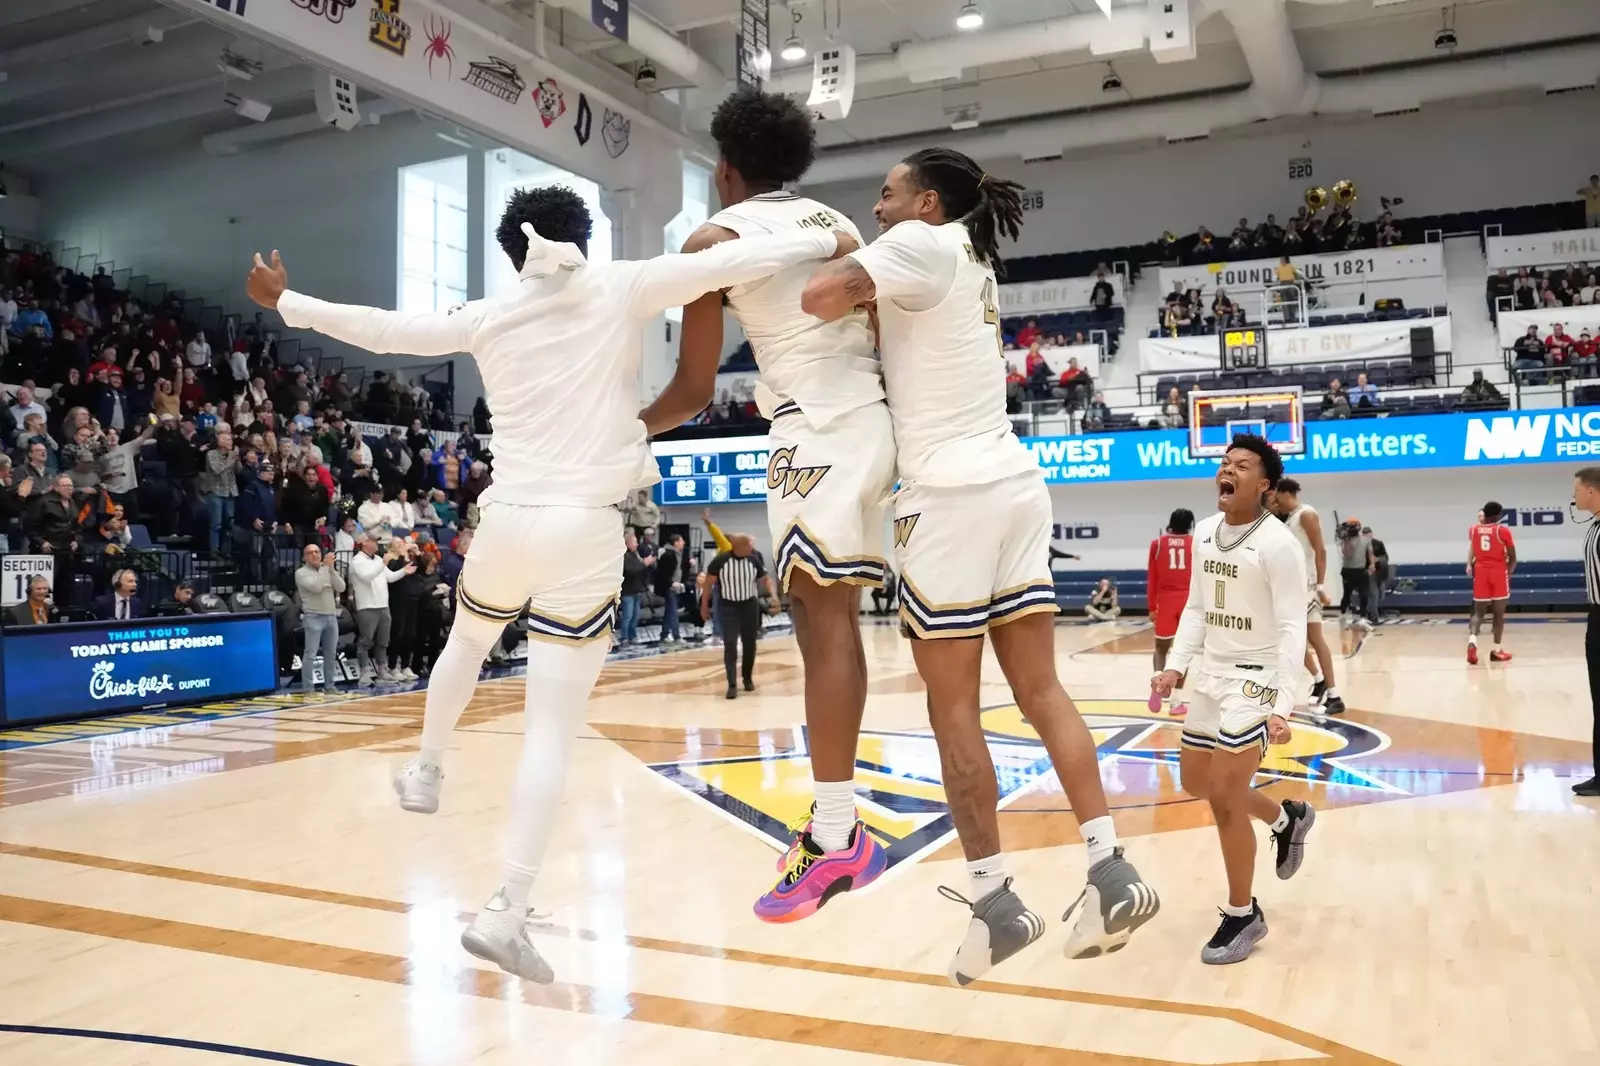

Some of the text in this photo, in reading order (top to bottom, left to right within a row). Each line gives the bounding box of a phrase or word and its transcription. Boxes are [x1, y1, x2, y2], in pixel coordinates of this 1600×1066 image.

[465, 73, 519, 104] BONNIES
[1288, 164, 1313, 179] 220
[1022, 195, 1044, 211] 219
[1552, 237, 1600, 255] HAIL
[1216, 267, 1273, 286] FOUND
[1333, 258, 1375, 277] 1821
[1312, 432, 1437, 460] Matters.
[1463, 414, 1552, 461] NW
[1022, 438, 1115, 464] HWEST
[700, 455, 712, 473] 7
[766, 443, 833, 500] GW
[1062, 463, 1111, 479] UNION
[893, 512, 922, 549] W
[1480, 534, 1491, 552] 6
[3, 560, 53, 572] SECTION
[1168, 547, 1187, 570] 11
[1203, 559, 1239, 579] GEORGE
[1214, 579, 1226, 609] 0
[107, 627, 190, 641] THANK YOU TO
[70, 635, 224, 658] TODAY'S GAME SPONSOR
[89, 662, 212, 700] Chick-fil-A DUPONT
